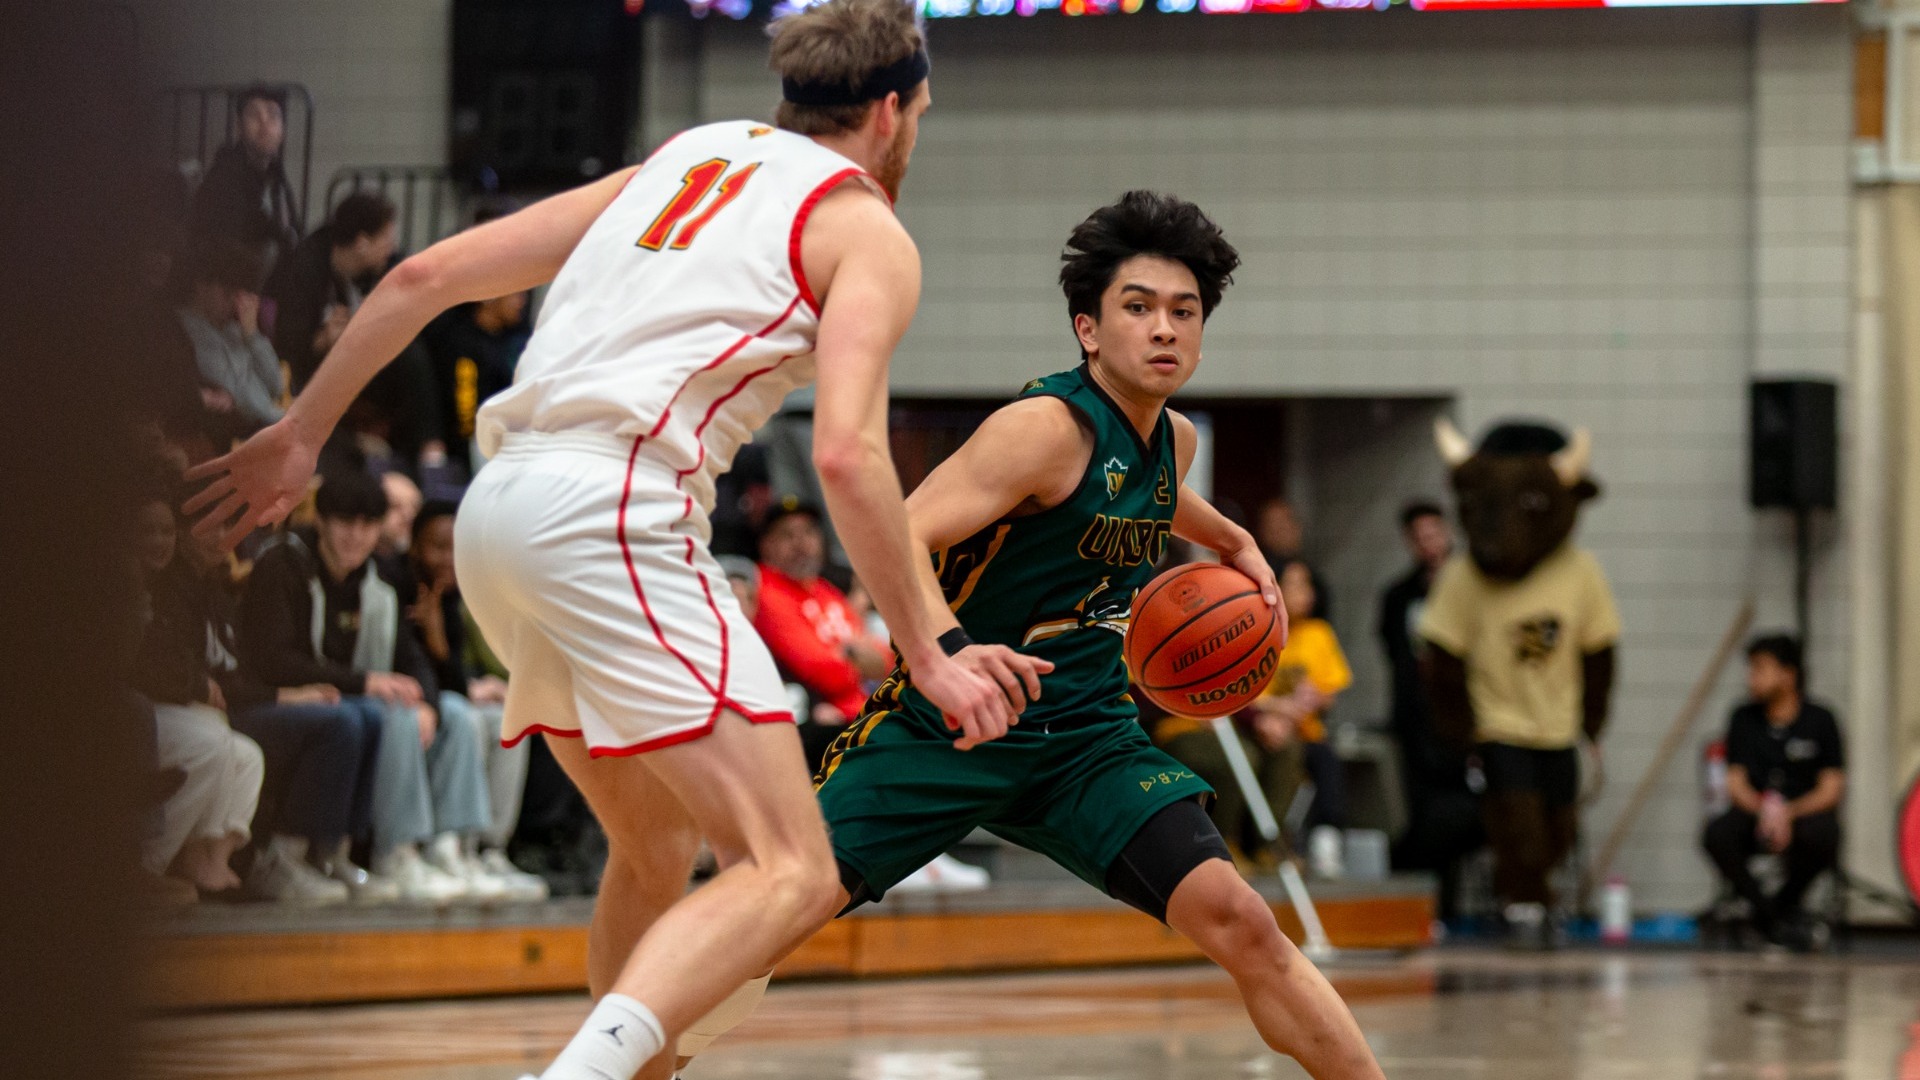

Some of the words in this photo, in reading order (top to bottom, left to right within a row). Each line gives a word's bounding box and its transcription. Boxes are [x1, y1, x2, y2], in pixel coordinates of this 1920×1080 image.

[635, 157, 763, 252] 11
[1154, 466, 1170, 504] 2
[1172, 613, 1255, 673] EVOLUTION
[1188, 646, 1277, 705] Wilson
